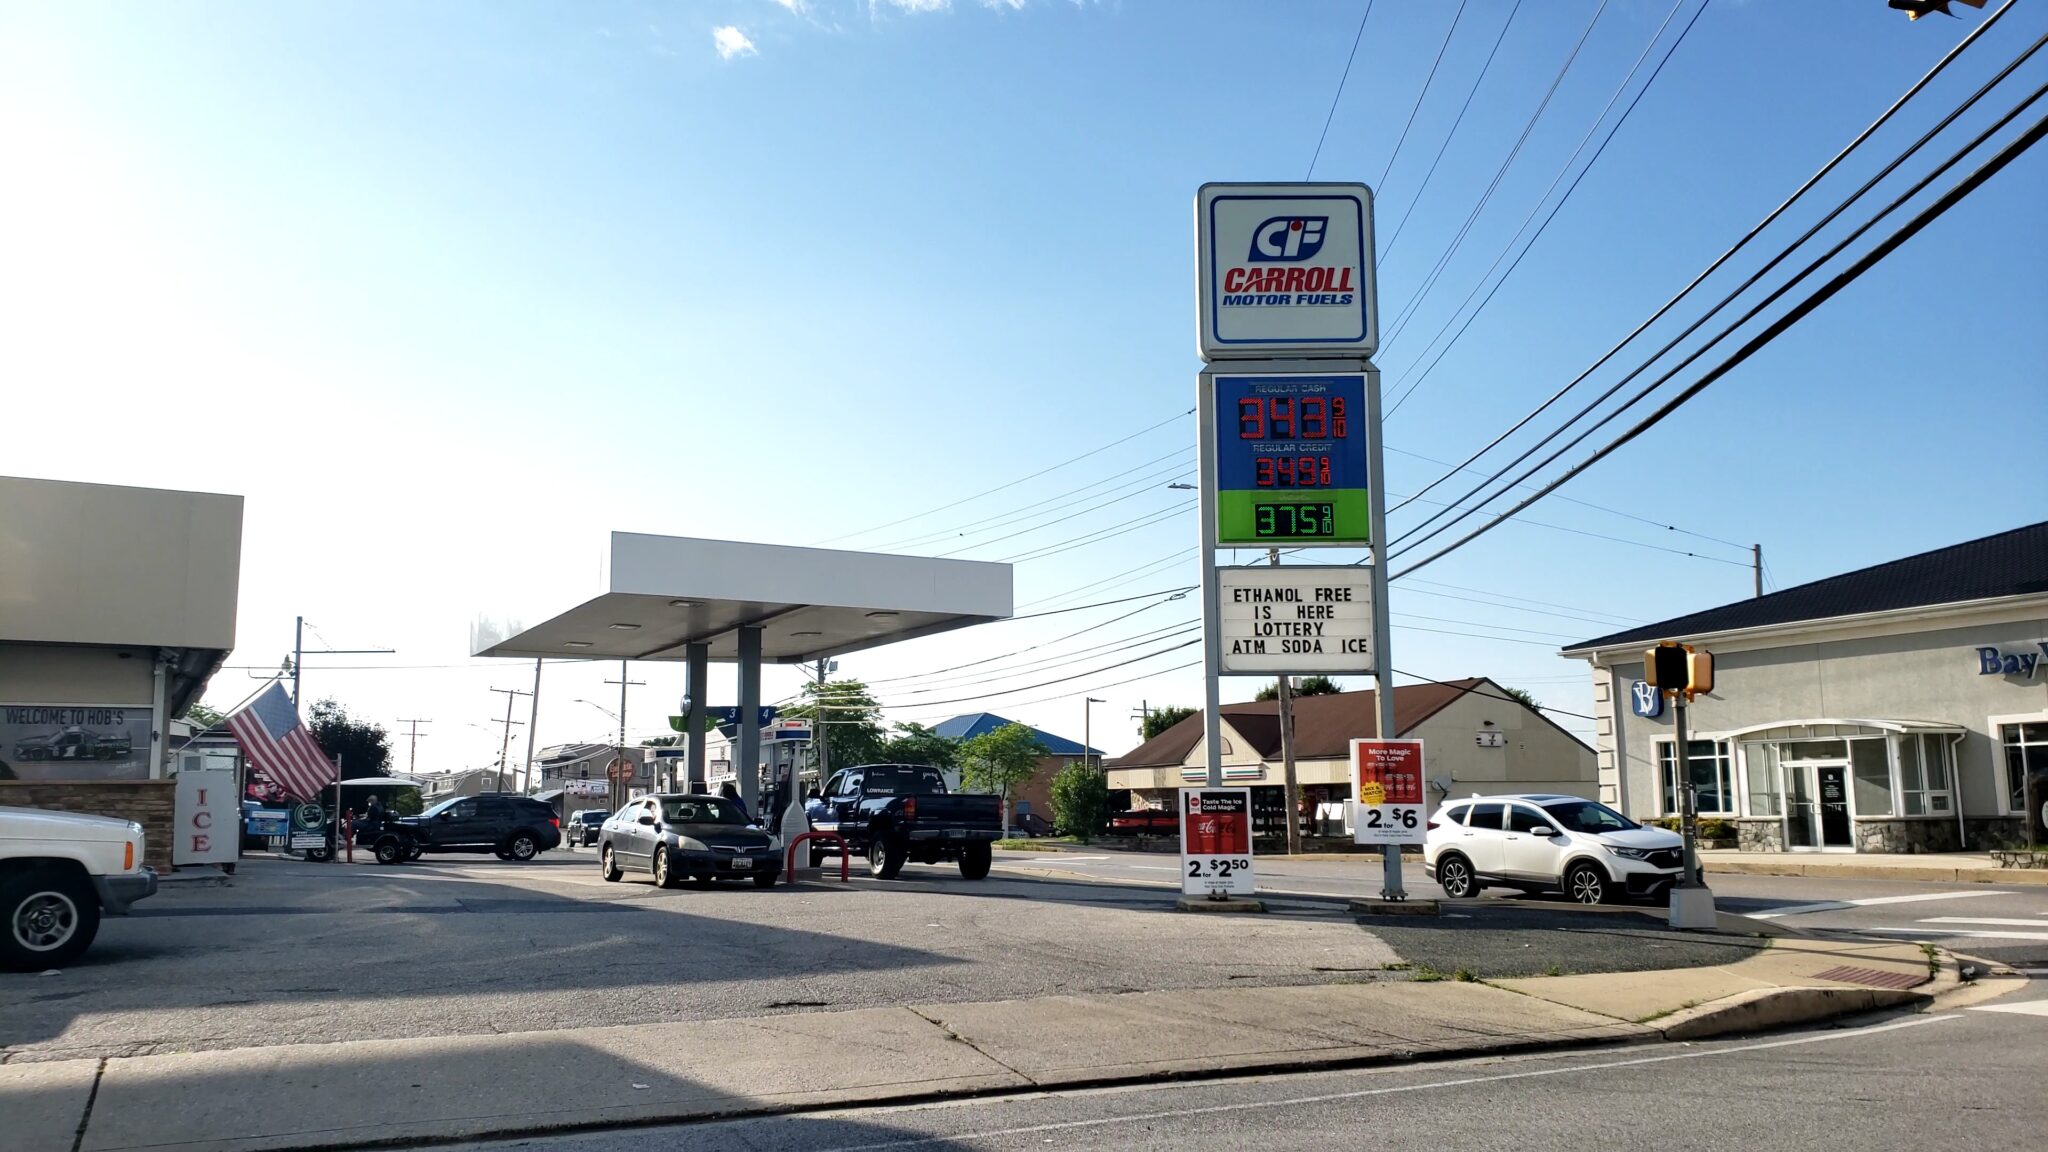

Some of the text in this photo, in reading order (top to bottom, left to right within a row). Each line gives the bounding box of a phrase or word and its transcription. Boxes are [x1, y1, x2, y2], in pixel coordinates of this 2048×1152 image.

[1224, 266, 1354, 293] CARROLL
[1222, 294, 1353, 306] MOTOR FUELS
[1255, 384, 1326, 393] REGULAR CASH
[1239, 397, 1326, 438] 343
[1253, 443, 1333, 452] REGULAR CREDIT
[1256, 457, 1316, 486] 349
[1258, 506, 1317, 534] 375
[1233, 588, 1352, 602] ETHANOL FREE
[1254, 605, 1334, 619] IS HERE
[1254, 622, 1324, 636] LOTTERY
[1232, 639, 1367, 654] ATM SODA ICE
[6, 708, 124, 726] WELCOME TO HOB'S
[729, 708, 736, 719] 3
[762, 708, 770, 719] 4
[1389, 748, 1412, 756] Magic
[191, 788, 212, 852] ICE
[1367, 809, 1382, 829] 2
[1188, 860, 1202, 877] 2
